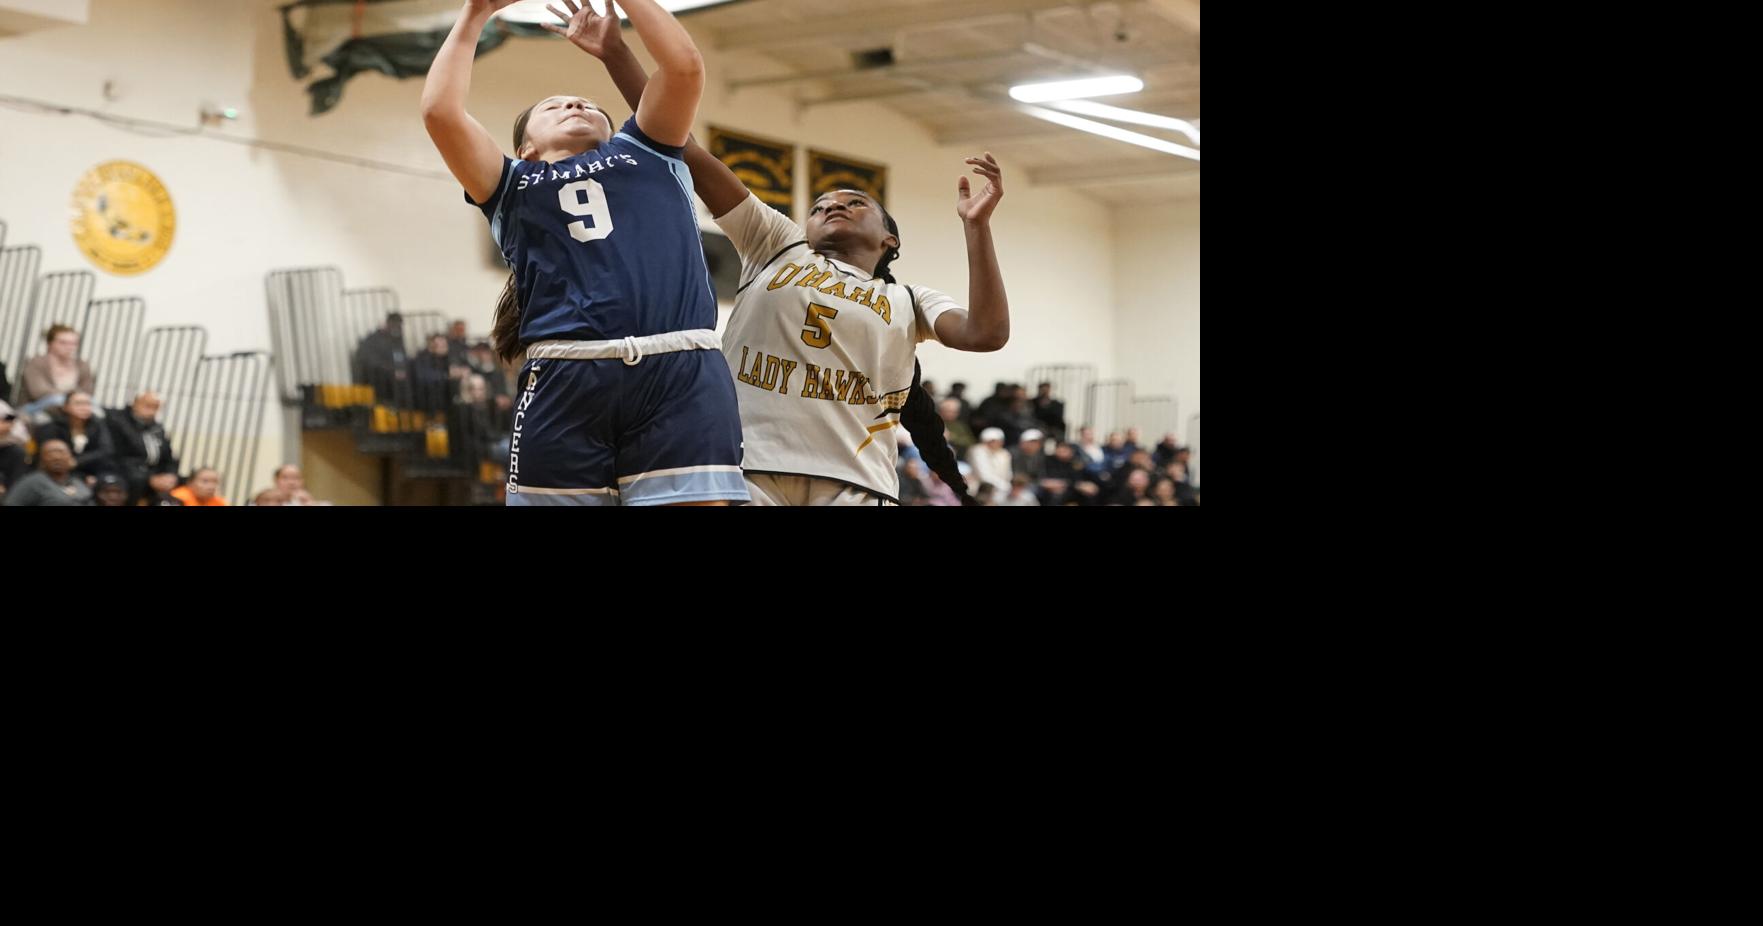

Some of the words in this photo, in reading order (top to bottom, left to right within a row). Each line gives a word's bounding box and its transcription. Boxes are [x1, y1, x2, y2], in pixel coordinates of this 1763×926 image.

[558, 177, 614, 243] 9
[800, 301, 839, 349] 5
[737, 345, 798, 395] LADY
